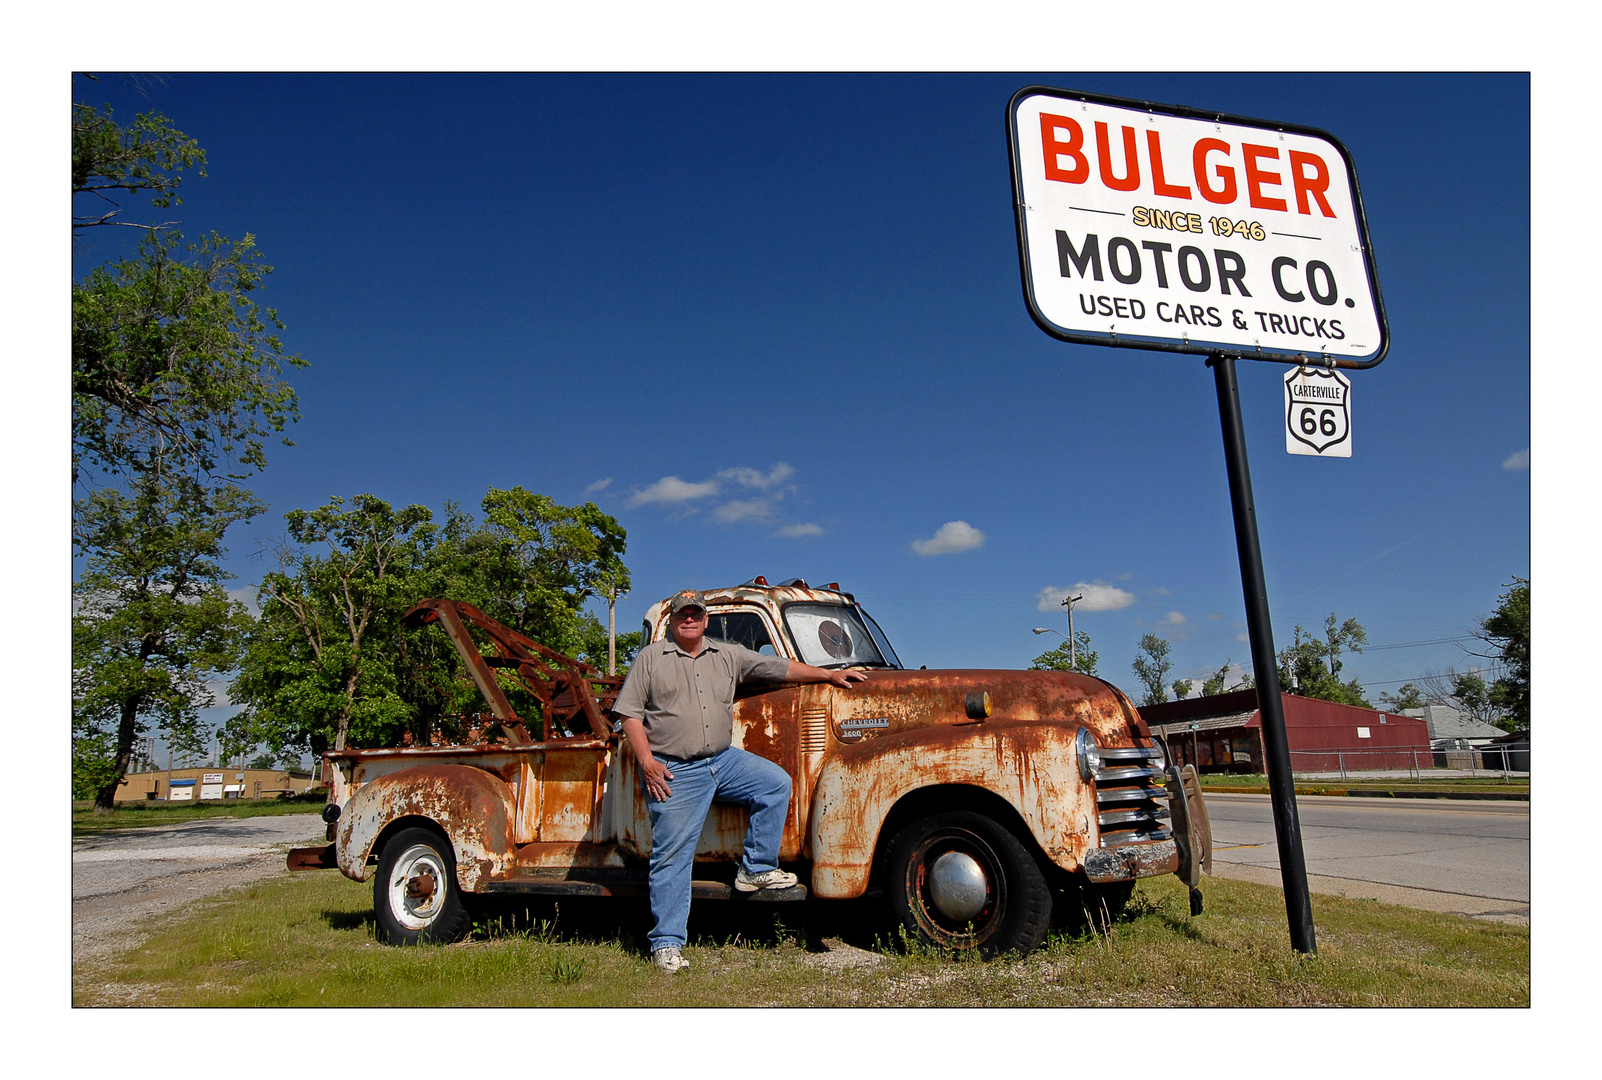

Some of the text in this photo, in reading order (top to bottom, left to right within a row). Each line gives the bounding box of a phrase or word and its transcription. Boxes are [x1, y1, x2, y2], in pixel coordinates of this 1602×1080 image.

[1039, 111, 1338, 219] BULGER
[1132, 205, 1266, 242] SINCE 1946
[1054, 229, 1356, 309] MOTOR CO.
[1079, 293, 1346, 340] USED CARS & TRUCKS
[1293, 384, 1340, 400] CARTERVILLE
[1300, 407, 1337, 437] 66
[841, 717, 889, 727] CHEVROLET
